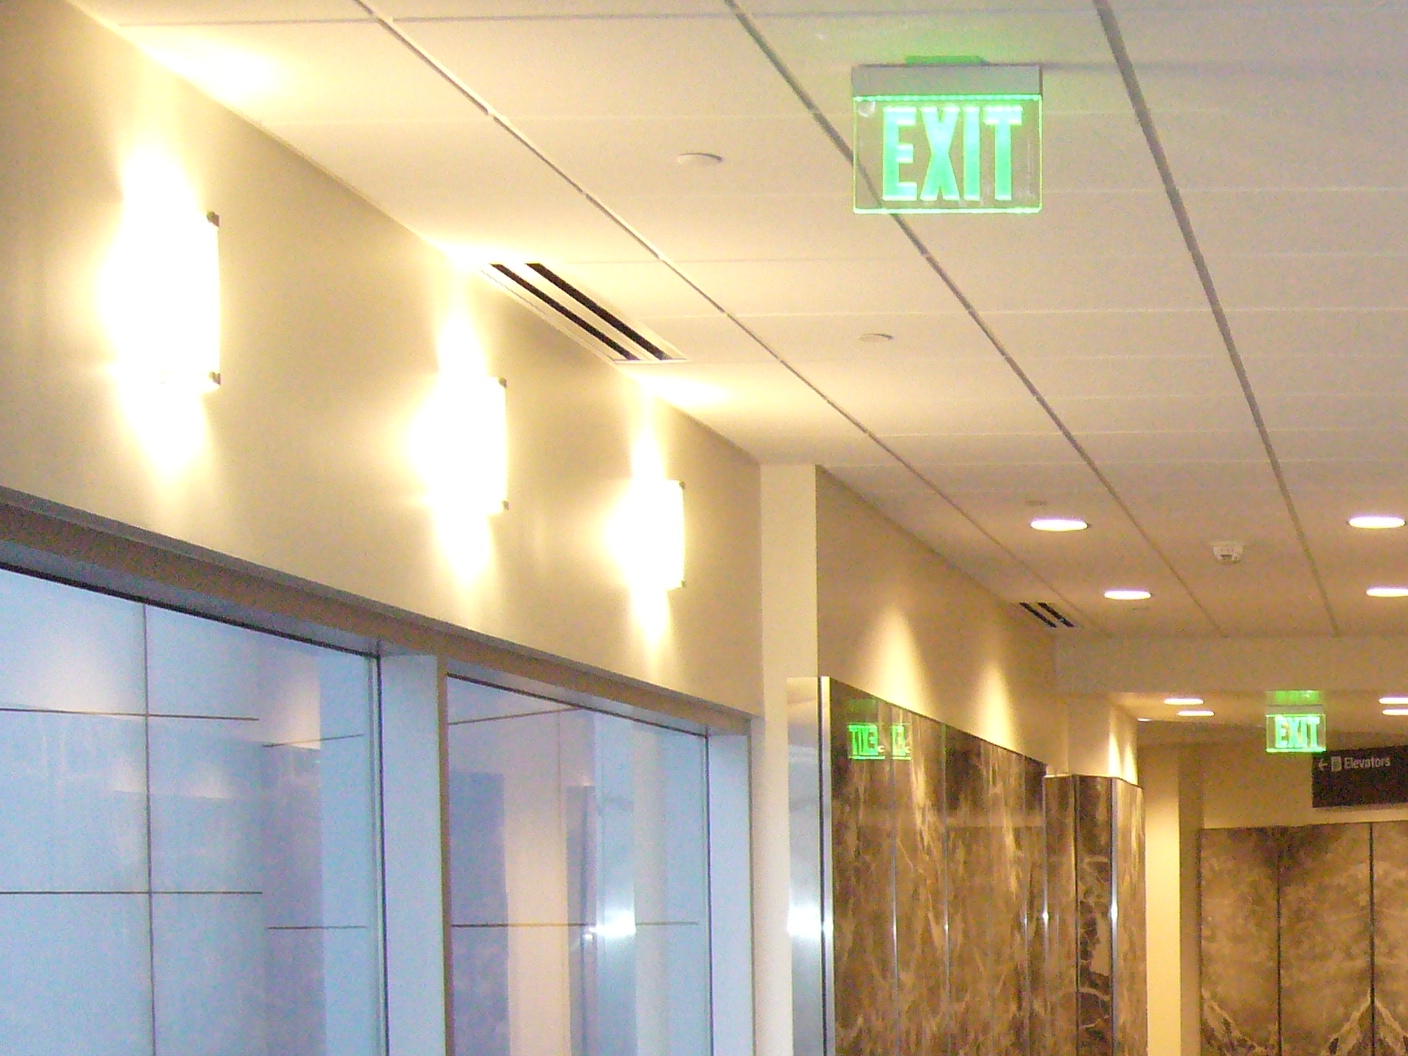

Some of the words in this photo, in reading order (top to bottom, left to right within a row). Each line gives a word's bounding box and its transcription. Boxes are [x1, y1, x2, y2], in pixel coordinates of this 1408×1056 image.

[882, 106, 1023, 201] EXIT
[1275, 714, 1320, 748] EXIT
[1344, 756, 1391, 769] Elevators
